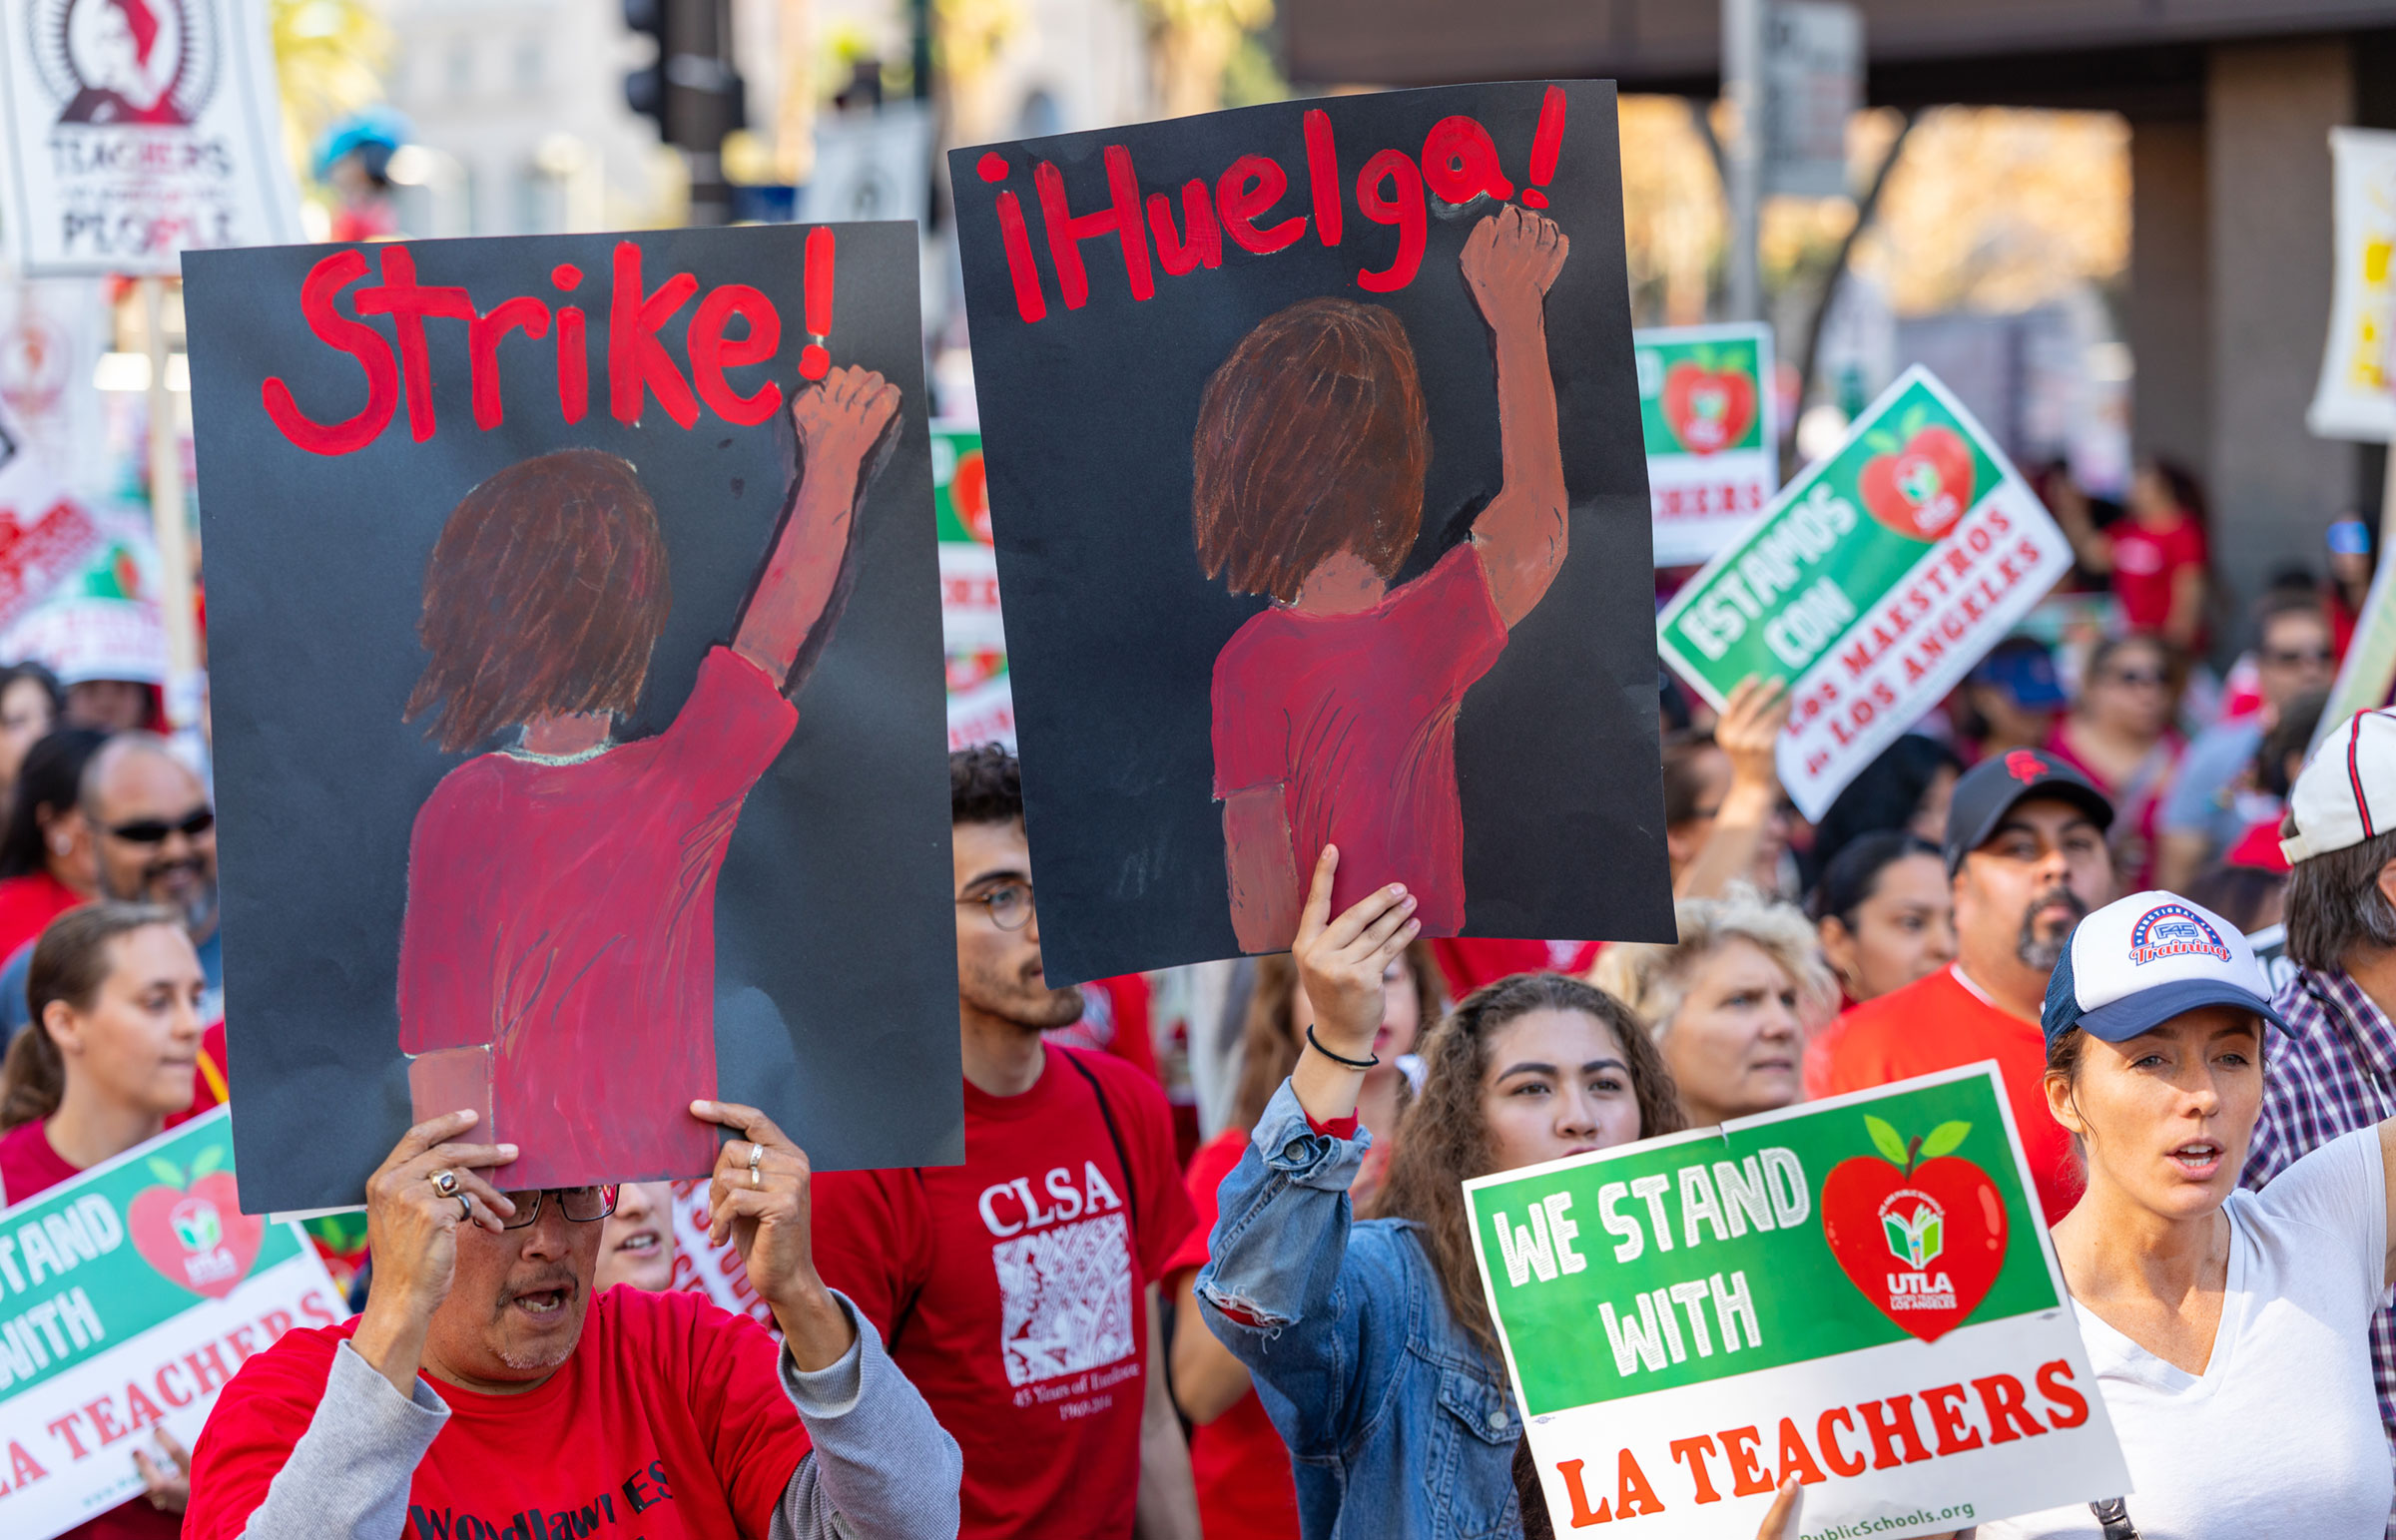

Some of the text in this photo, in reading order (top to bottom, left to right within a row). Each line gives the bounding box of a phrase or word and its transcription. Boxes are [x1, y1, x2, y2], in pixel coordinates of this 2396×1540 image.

[976, 85, 1566, 323] ¡Huelga!
[263, 226, 836, 456] Strike!
[1677, 481, 1857, 661] ESTAMOS
[1763, 576, 1856, 670] CON
[1840, 506, 2011, 676] MAESTROS
[1829, 683, 1895, 748] LOS
[1900, 540, 2043, 685] ANGELES
[2128, 939, 2232, 966] Training
[0, 1193, 124, 1303] TAND
[977, 1160, 1122, 1238] CLSA
[1493, 1147, 1811, 1287] WE STAND
[1597, 1271, 1763, 1377] WITH
[1887, 1273, 1955, 1294] UTLA
[1891, 1299, 1958, 1310] LOS ANGELES
[0, 1440, 48, 1497] A
[47, 1290, 336, 1462] TEACHERS
[1071, 1373, 1089, 1395] of
[1556, 1358, 2090, 1529] LA TEACHERS
[408, 1459, 674, 1540] Wodlaw ES
